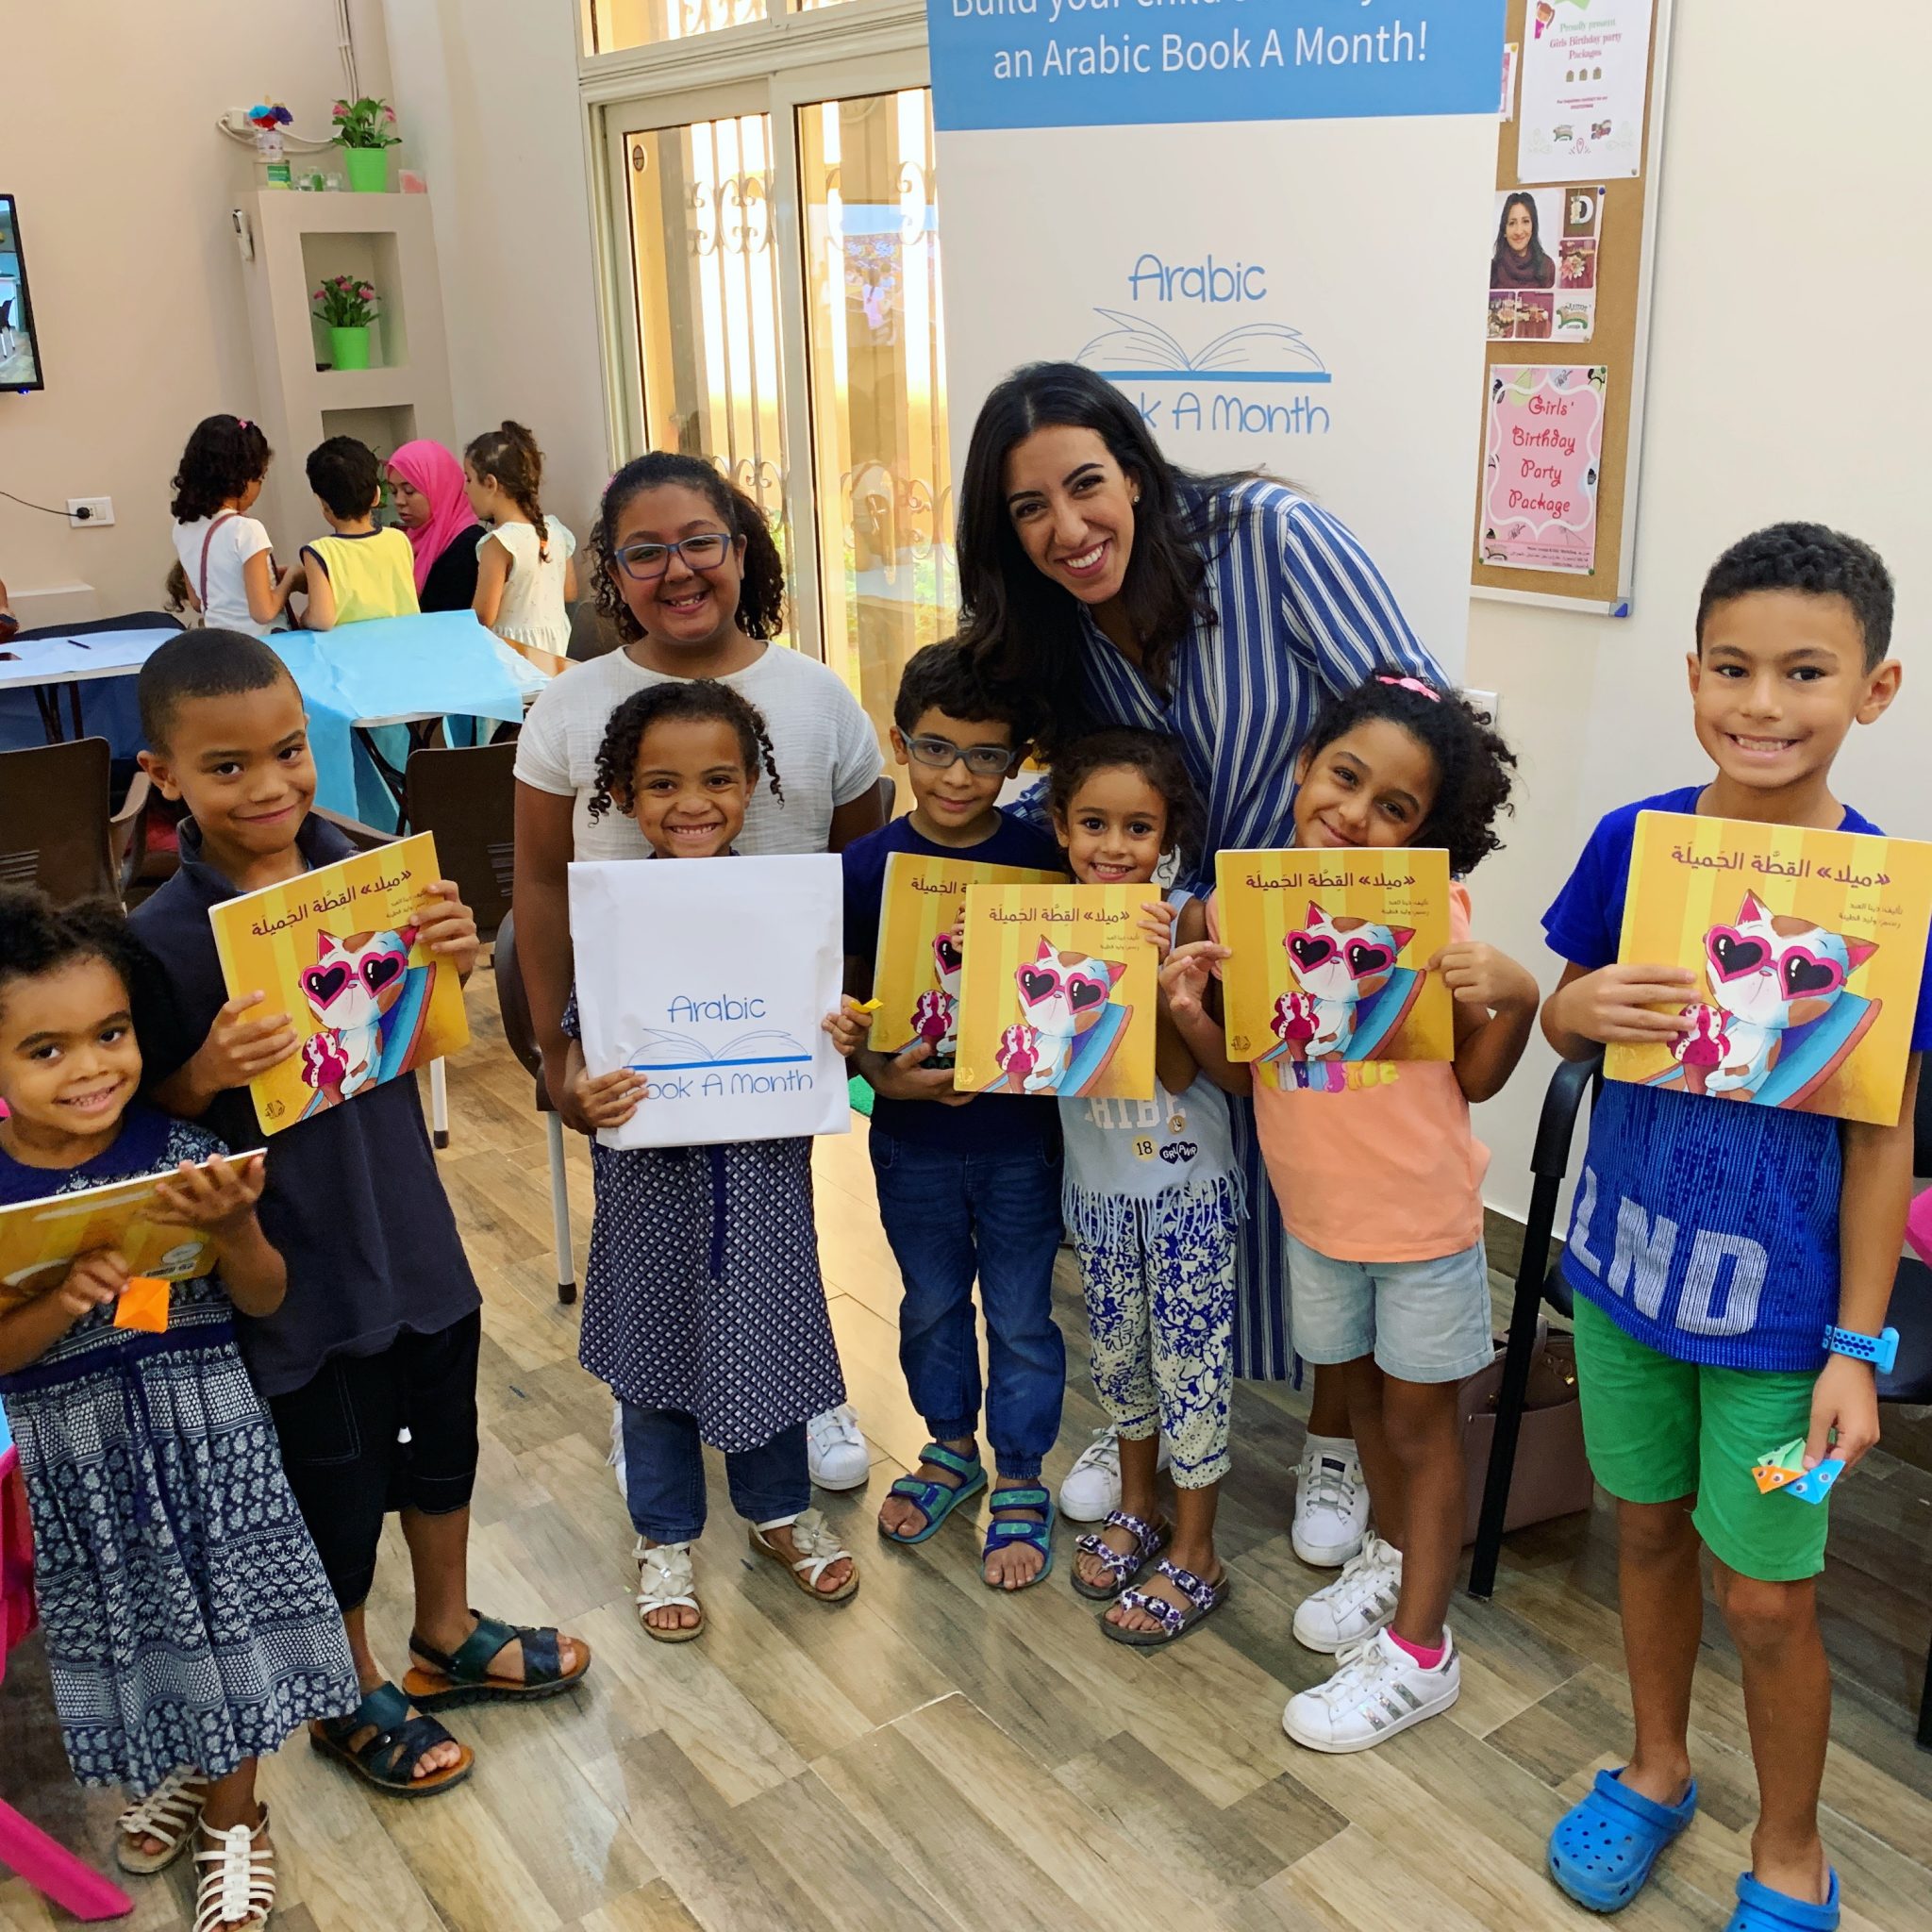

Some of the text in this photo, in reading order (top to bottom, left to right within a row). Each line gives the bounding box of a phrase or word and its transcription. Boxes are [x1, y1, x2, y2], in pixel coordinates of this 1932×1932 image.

[994, 20, 1426, 79] an Arabic Book A Month!
[1570, 35, 1601, 46] Birthday
[1128, 254, 1267, 302] Arabic
[1172, 391, 1201, 431] A
[1212, 391, 1330, 434] Month
[1528, 394, 1574, 416] Girls'
[1512, 425, 1575, 457] Birthday
[1521, 458, 1562, 487] Party
[1509, 489, 1571, 519] Package
[667, 993, 767, 1024] Arabic
[625, 1069, 813, 1100] ook A Month
[1137, 1141, 1154, 1156] 18
[1162, 1144, 1197, 1158] GRL PWR
